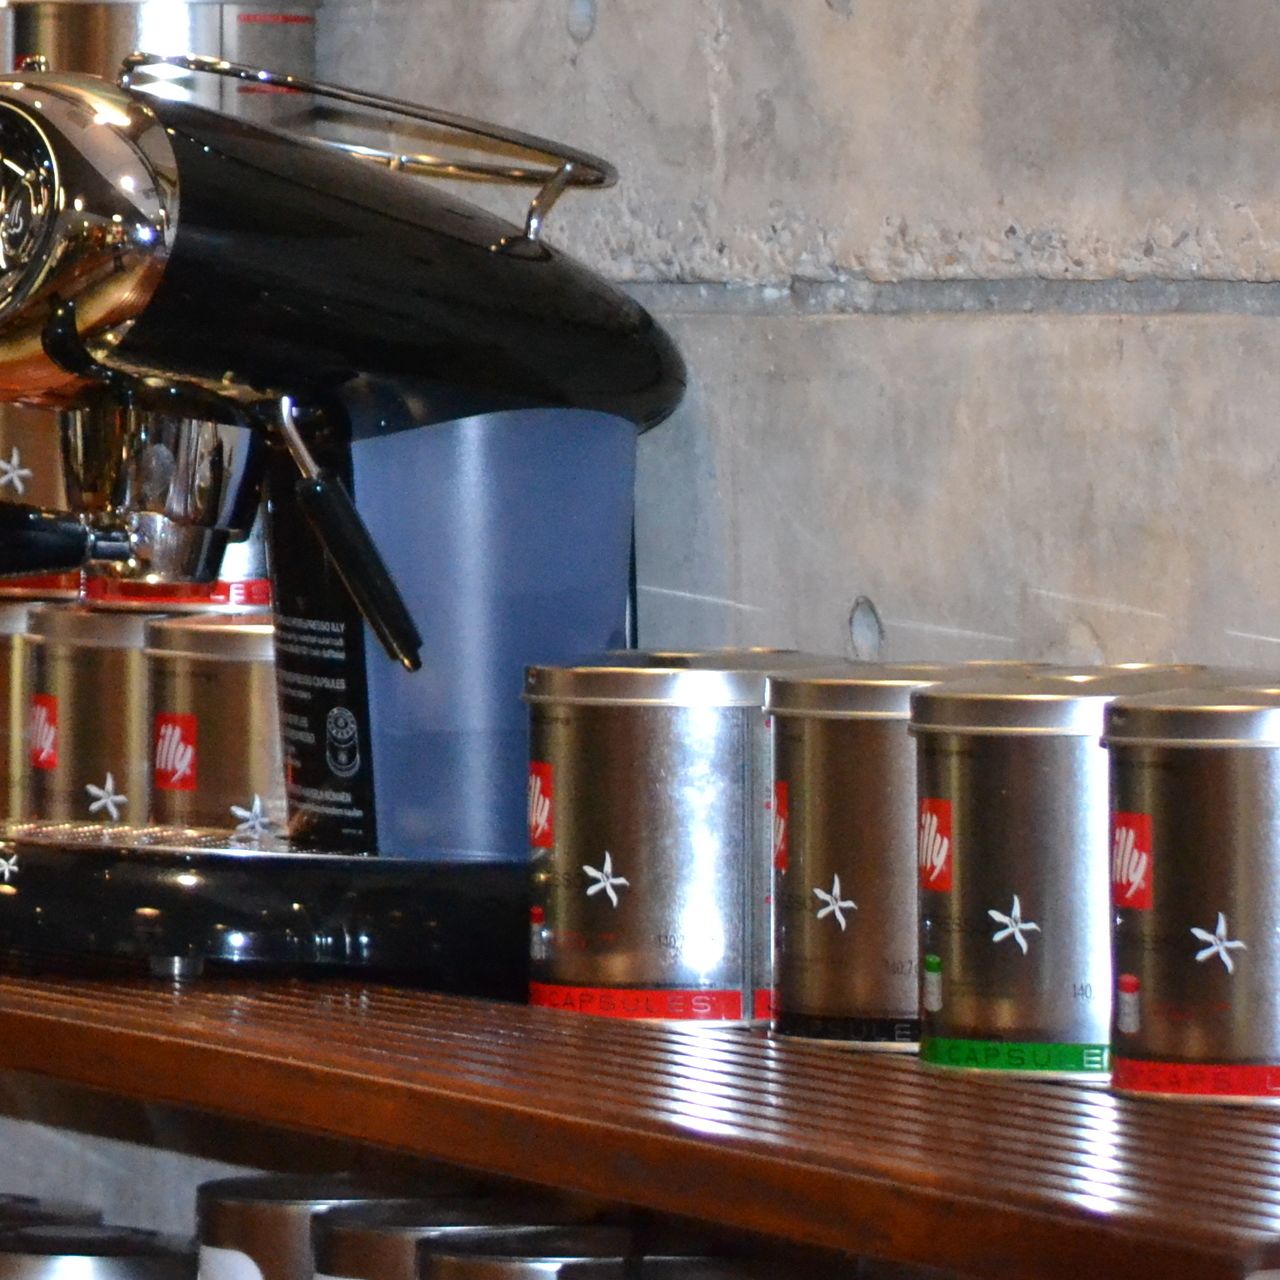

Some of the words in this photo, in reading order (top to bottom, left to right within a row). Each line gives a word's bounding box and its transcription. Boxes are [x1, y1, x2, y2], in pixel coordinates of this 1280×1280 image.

[156, 724, 195, 782] illy
[920, 811, 949, 882] illy
[1112, 826, 1148, 898] illy
